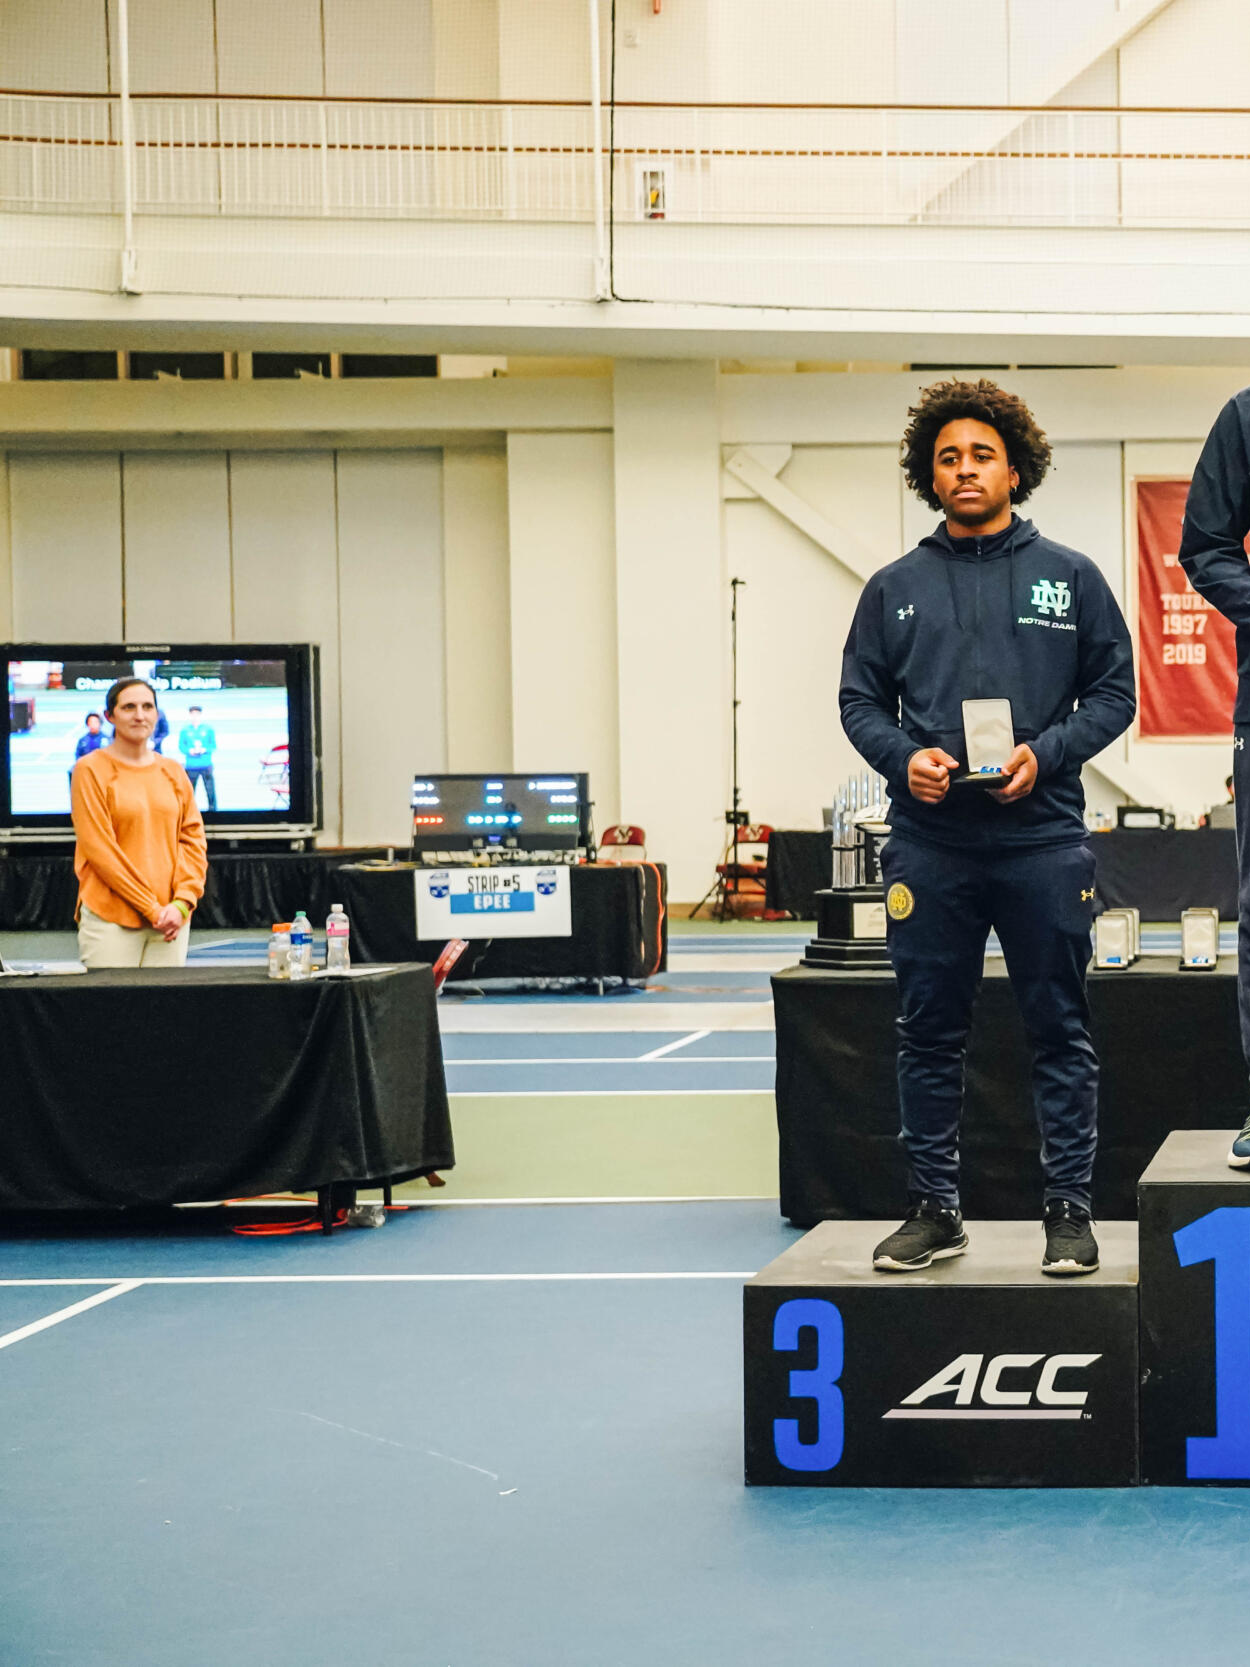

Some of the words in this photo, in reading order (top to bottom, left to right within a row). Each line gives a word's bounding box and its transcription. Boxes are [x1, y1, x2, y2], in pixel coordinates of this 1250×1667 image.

[1031, 579, 1071, 617] ND
[1018, 617, 1051, 628] NOTRE
[1162, 613, 1208, 635] 1997
[1162, 643, 1207, 665] 2019
[171, 676, 222, 690] Podium
[468, 875, 499, 893] STRIP
[473, 894, 511, 910] EPEE
[772, 1298, 845, 1472] 3
[899, 1353, 1103, 1405] ACC
